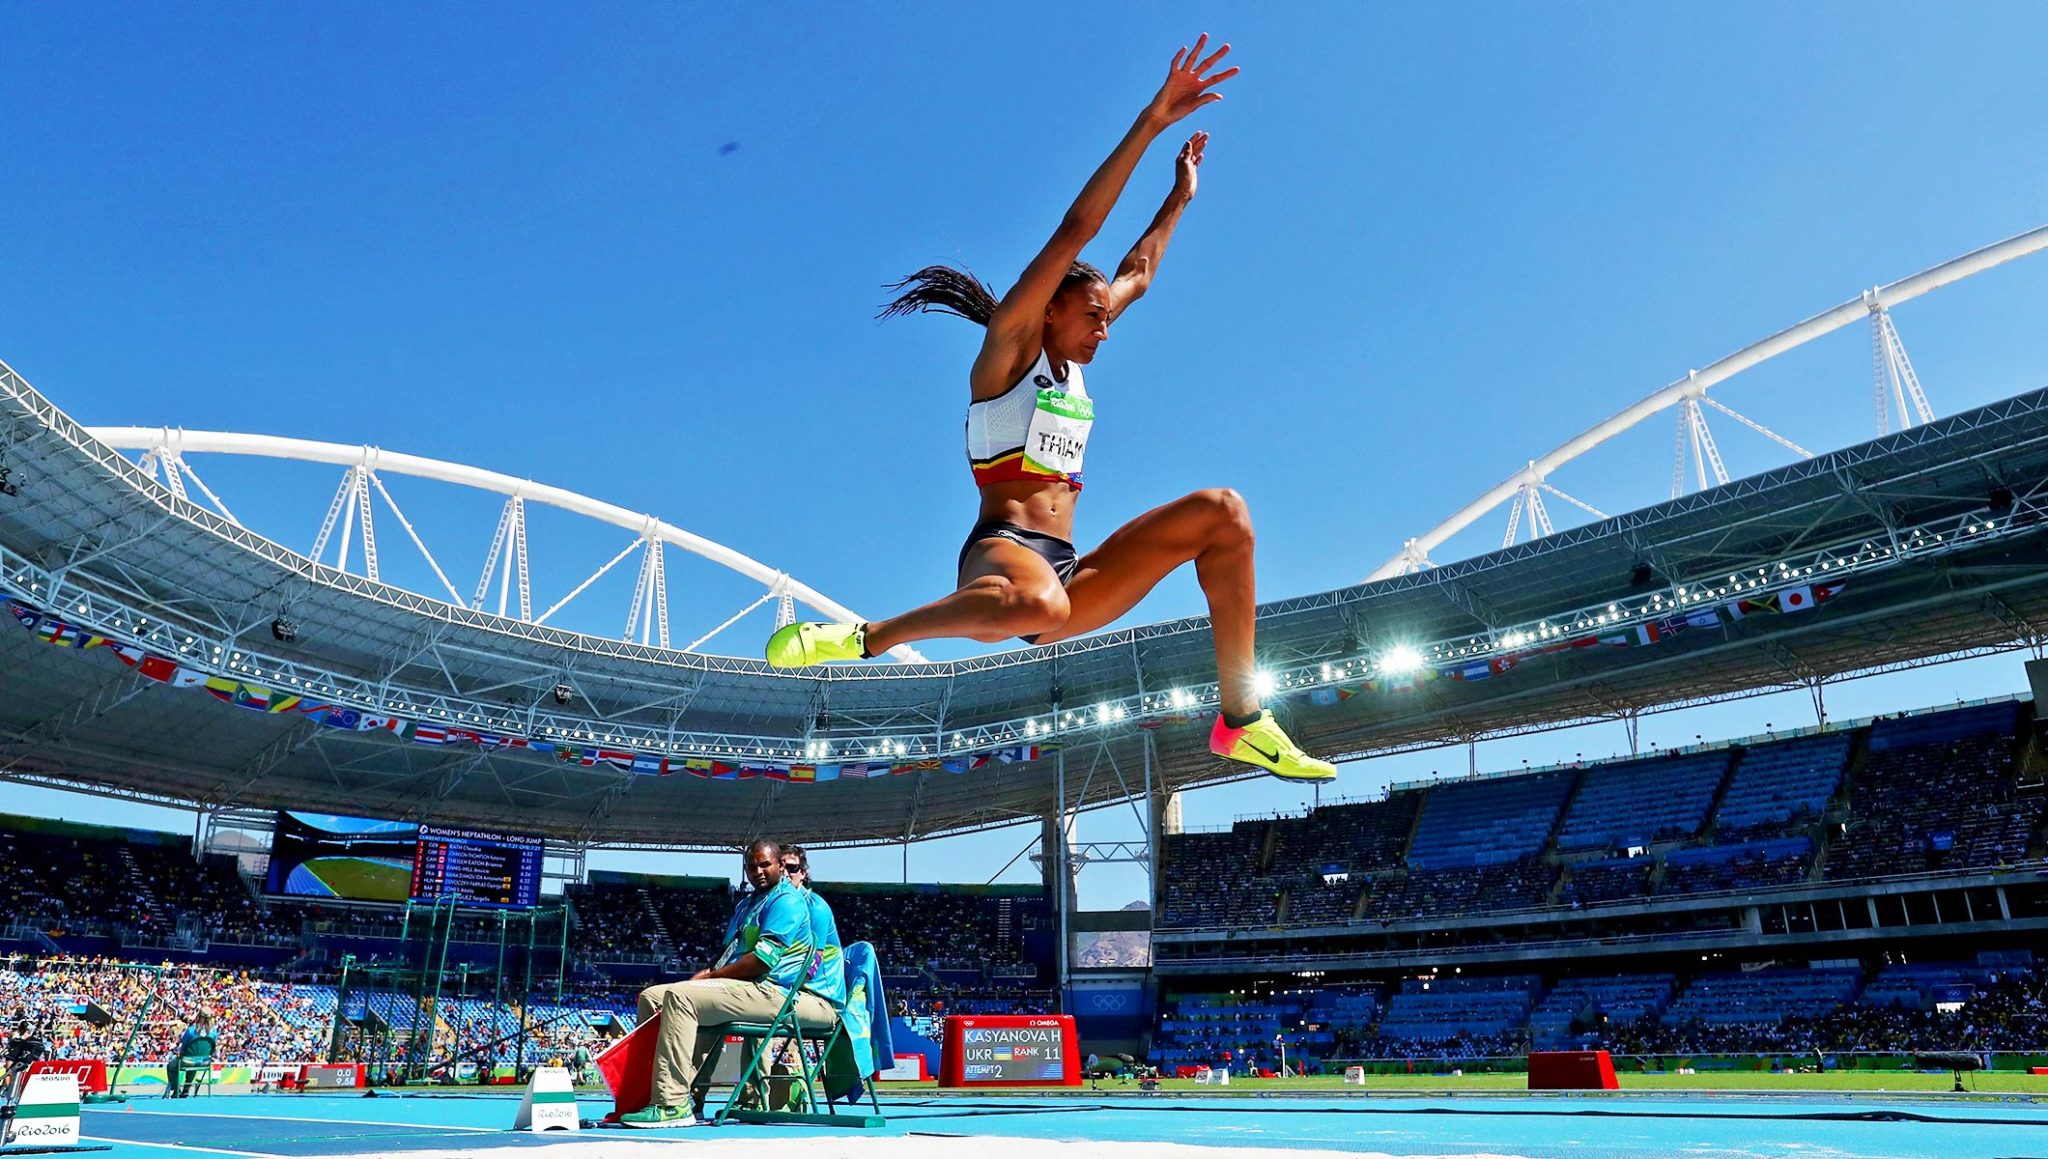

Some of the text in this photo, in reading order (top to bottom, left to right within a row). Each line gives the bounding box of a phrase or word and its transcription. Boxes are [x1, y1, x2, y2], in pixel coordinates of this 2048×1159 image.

[429, 827, 460, 837] WOMEN'S
[461, 830, 501, 841] HEPTATHLON
[506, 835, 525, 843] LONG
[964, 1030, 1061, 1043] KASYANOVA H
[966, 1047, 1061, 1061] UKR RANK 11
[964, 1064, 1003, 1078] ATTEMPT 2
[538, 1108, 573, 1119] Rio2016
[17, 1123, 71, 1137] Rio2016
